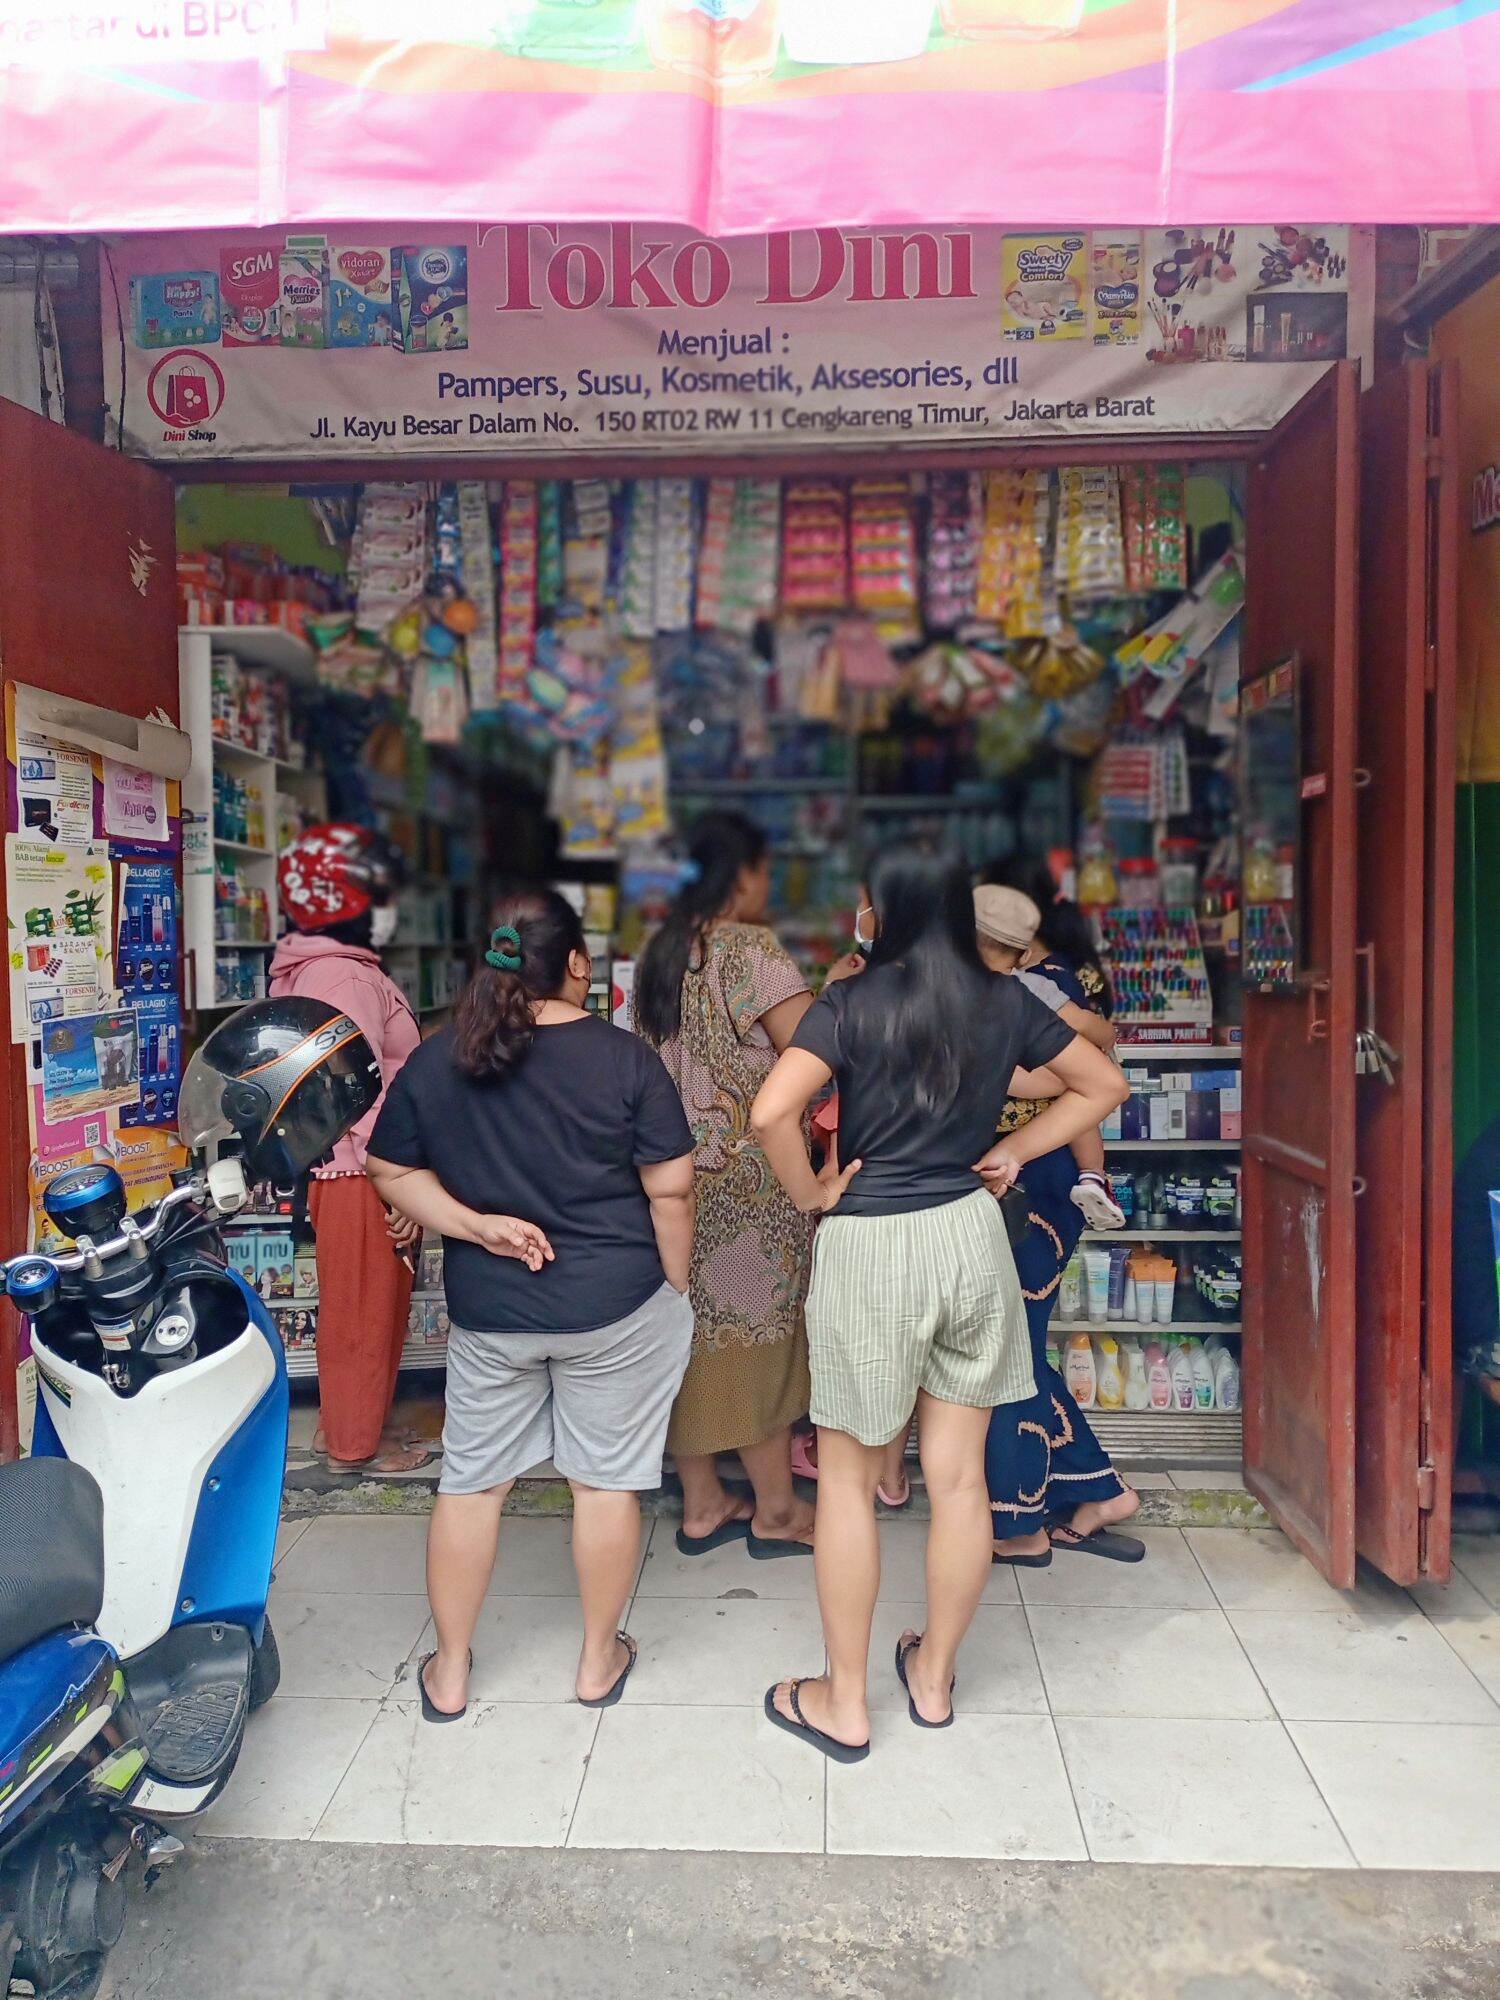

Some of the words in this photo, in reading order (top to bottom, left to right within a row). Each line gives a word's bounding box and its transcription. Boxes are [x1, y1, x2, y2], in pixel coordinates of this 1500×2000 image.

[232, 251, 274, 281] SGM
[340, 257, 381, 270] vidoran
[477, 222, 732, 311] Toko
[755, 224, 978, 304] Dini
[1018, 250, 1072, 270] Sweety
[1020, 273, 1065, 282] Comfort
[283, 284, 321, 297] Merries
[658, 328, 772, 361] Menjual
[438, 372, 567, 402] Pampers,
[577, 369, 651, 399] Susu,
[662, 366, 803, 395] Kosmetik,
[811, 360, 972, 391] Aksesories,
[983, 357, 1019, 386] dll
[310, 418, 336, 439] Jl.
[344, 416, 396, 439] Kayu
[404, 414, 462, 436] Besar
[470, 413, 537, 435] Dalam
[544, 413, 579, 434] No.
[596, 411, 636, 432] 150
[642, 409, 698, 431] RT02
[706, 409, 741, 430] RW
[751, 410, 773, 429] 11
[782, 407, 913, 431] Cengkareng
[918, 403, 989, 426] Timur,
[1004, 399, 1089, 421] Jakarta
[1096, 396, 1155, 418] Barat
[163, 431, 185, 442] Dini
[187, 429, 216, 442] Shop
[132, 999, 166, 1009] BELLAGIO
